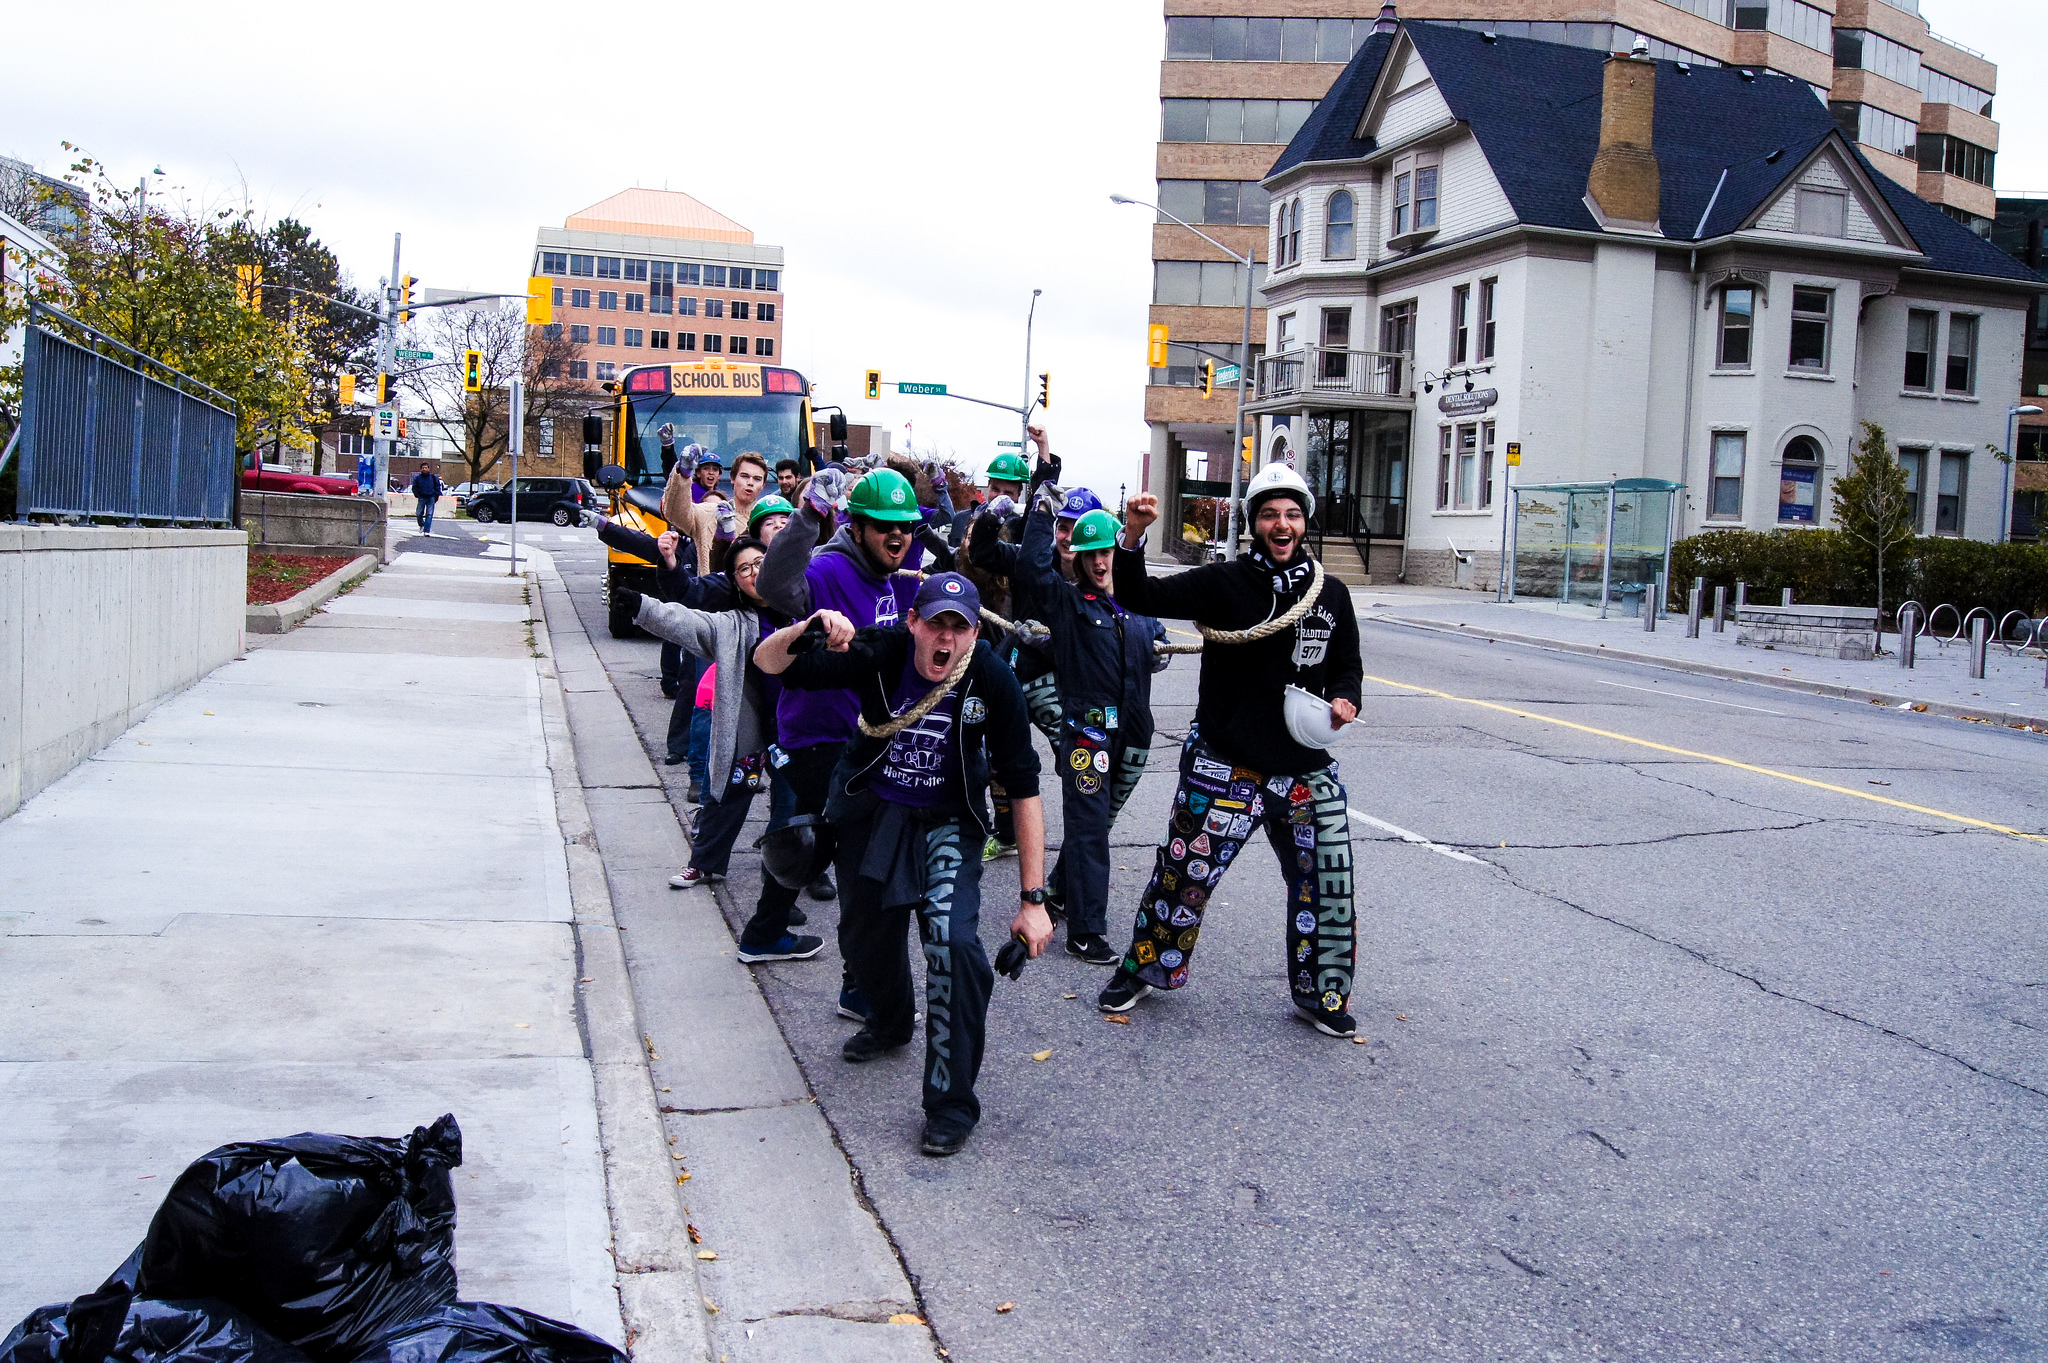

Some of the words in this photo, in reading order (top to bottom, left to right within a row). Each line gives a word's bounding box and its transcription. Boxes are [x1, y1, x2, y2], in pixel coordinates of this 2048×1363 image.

[398, 350, 421, 359] WEBER
[673, 372, 729, 389] SCHOOL
[733, 372, 760, 389] BUS
[1216, 368, 1235, 382] Frederick
[903, 384, 935, 394] Weber
[1445, 394, 1464, 403] DENTAL
[1301, 646, 1322, 659] 977
[883, 764, 913, 783] Harry
[914, 776, 945, 788] Potter
[1210, 771, 1228, 781] TOOL
